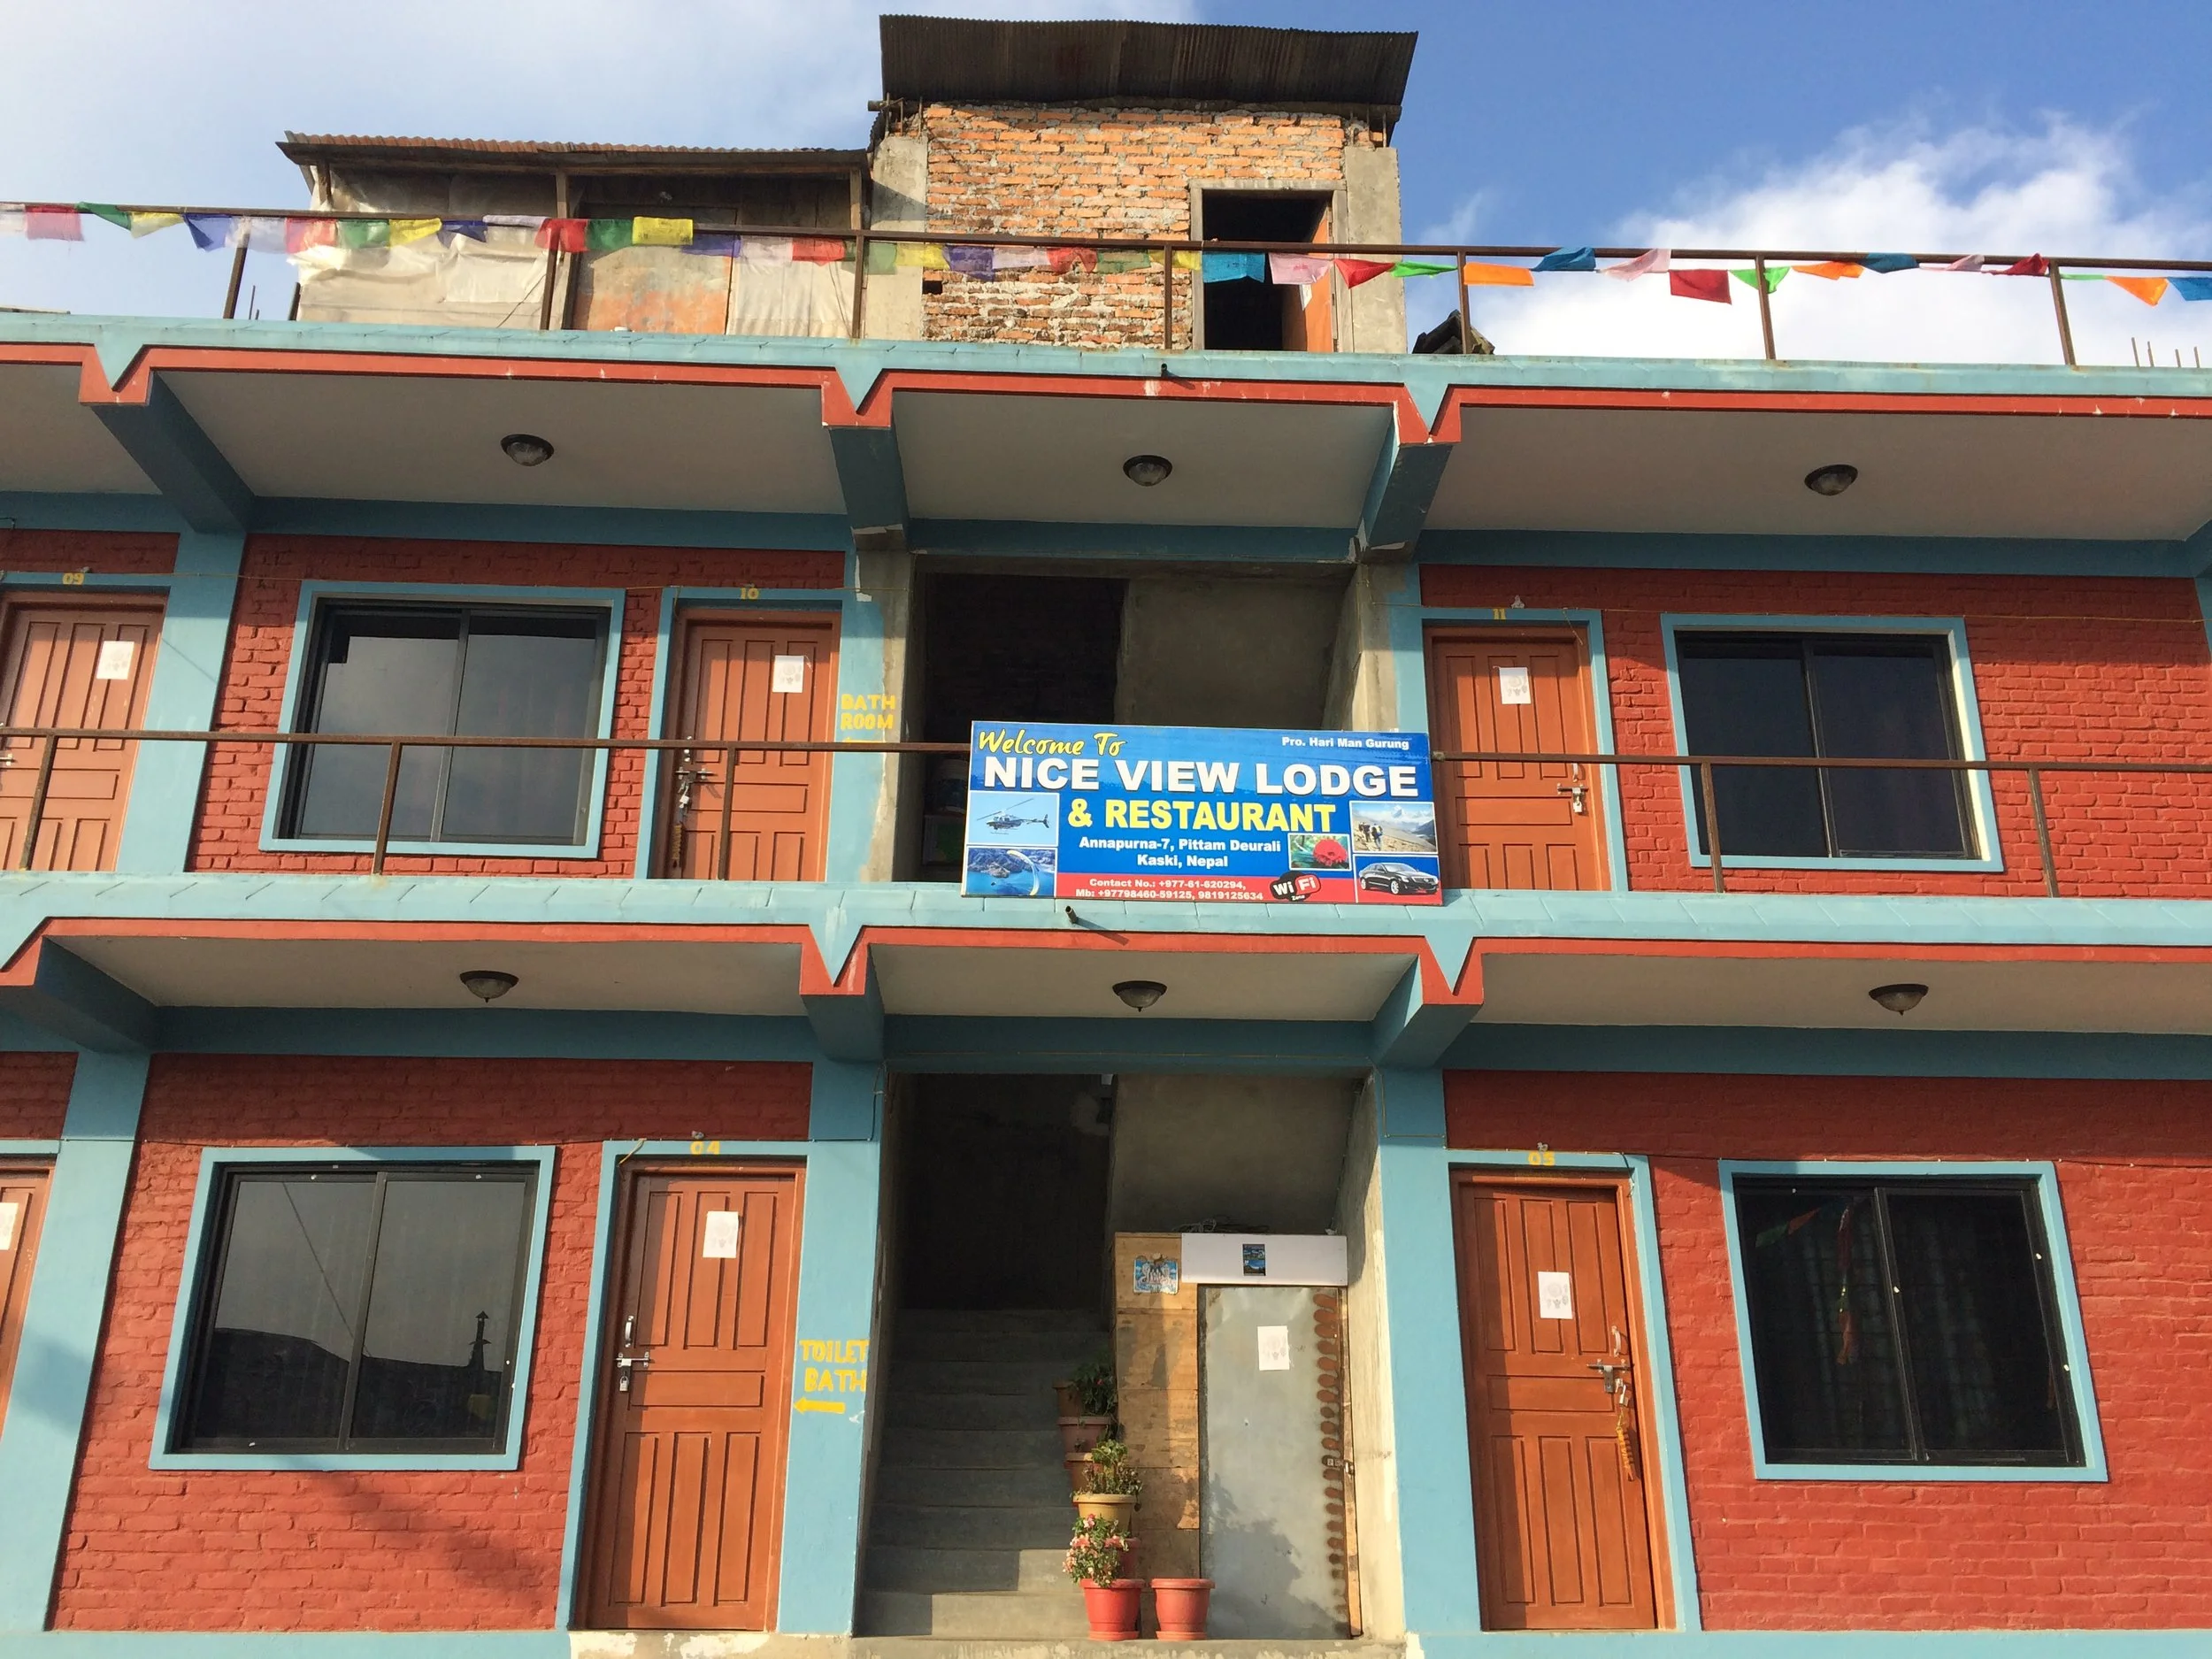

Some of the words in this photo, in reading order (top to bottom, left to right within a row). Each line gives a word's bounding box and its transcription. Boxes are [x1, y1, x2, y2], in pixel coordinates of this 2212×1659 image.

[63, 572, 84, 585] 09
[741, 588, 759, 600] 10
[1493, 608, 1506, 620] 11
[841, 694, 896, 710] BATH
[841, 713, 895, 730] ROOM
[979, 729, 1085, 756] Welcome
[1093, 733, 1127, 757] To
[1282, 736, 1306, 747] Pro.
[1310, 737, 1333, 747] Hari
[1337, 738, 1363, 748] Man
[1365, 738, 1409, 750] Gurung
[984, 756, 1100, 790] NICE
[1114, 759, 1240, 794] VIEW
[1256, 763, 1419, 797] LODGE
[1068, 798, 1093, 827] &
[1105, 799, 1336, 833] RESTAURANT
[1079, 836, 1175, 851] Annapurna-7,
[1179, 838, 1226, 851] Pittam
[1230, 839, 1281, 852] Deurali
[1137, 854, 1182, 869] Kaski,
[1187, 855, 1228, 869] Nepal
[1089, 878, 1132, 887] Contact
[1134, 879, 1156, 887] No.:
[1272, 880, 1294, 895] Wi
[1298, 877, 1317, 891] Fi
[1075, 888, 1095, 897] Mb:
[1198, 891, 1263, 900] 9819125634
[690, 1141, 720, 1155] 04
[1528, 1150, 1555, 1166] 05
[799, 1339, 871, 1363] TOILET
[804, 1367, 867, 1394] BATH
